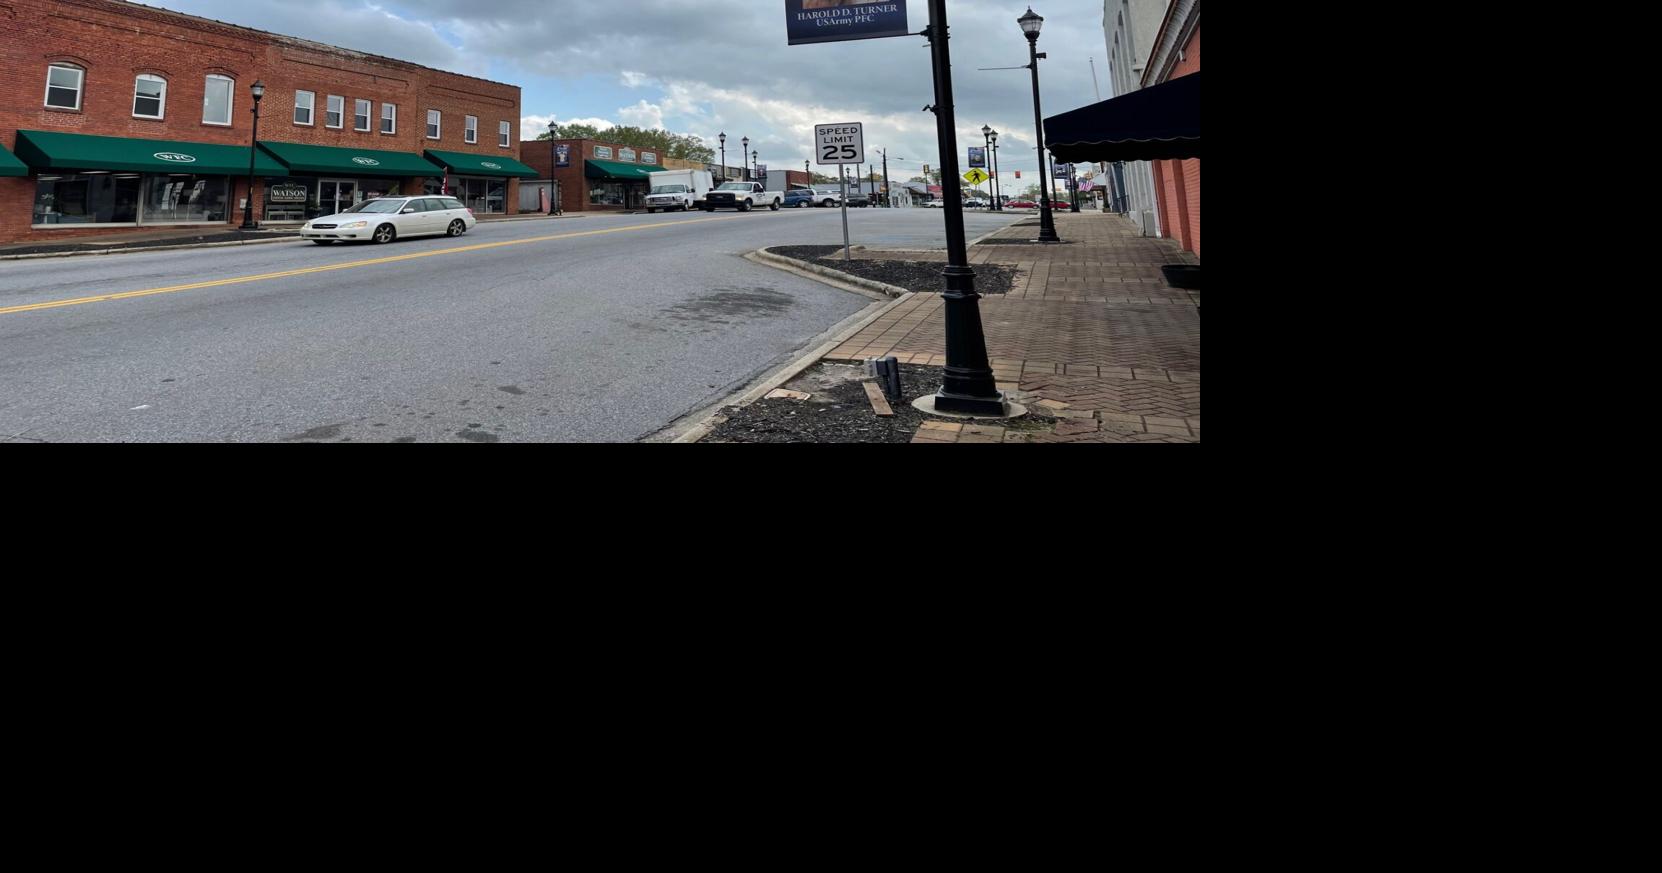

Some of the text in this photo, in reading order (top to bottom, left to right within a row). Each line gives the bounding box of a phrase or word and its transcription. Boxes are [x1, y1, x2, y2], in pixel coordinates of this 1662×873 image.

[797, 4, 898, 20] HAROLD D. TURNER
[816, 14, 876, 26] USArmy PFC
[819, 127, 858, 135] SPEED
[823, 135, 854, 143] LIMIT
[822, 144, 857, 160] 25
